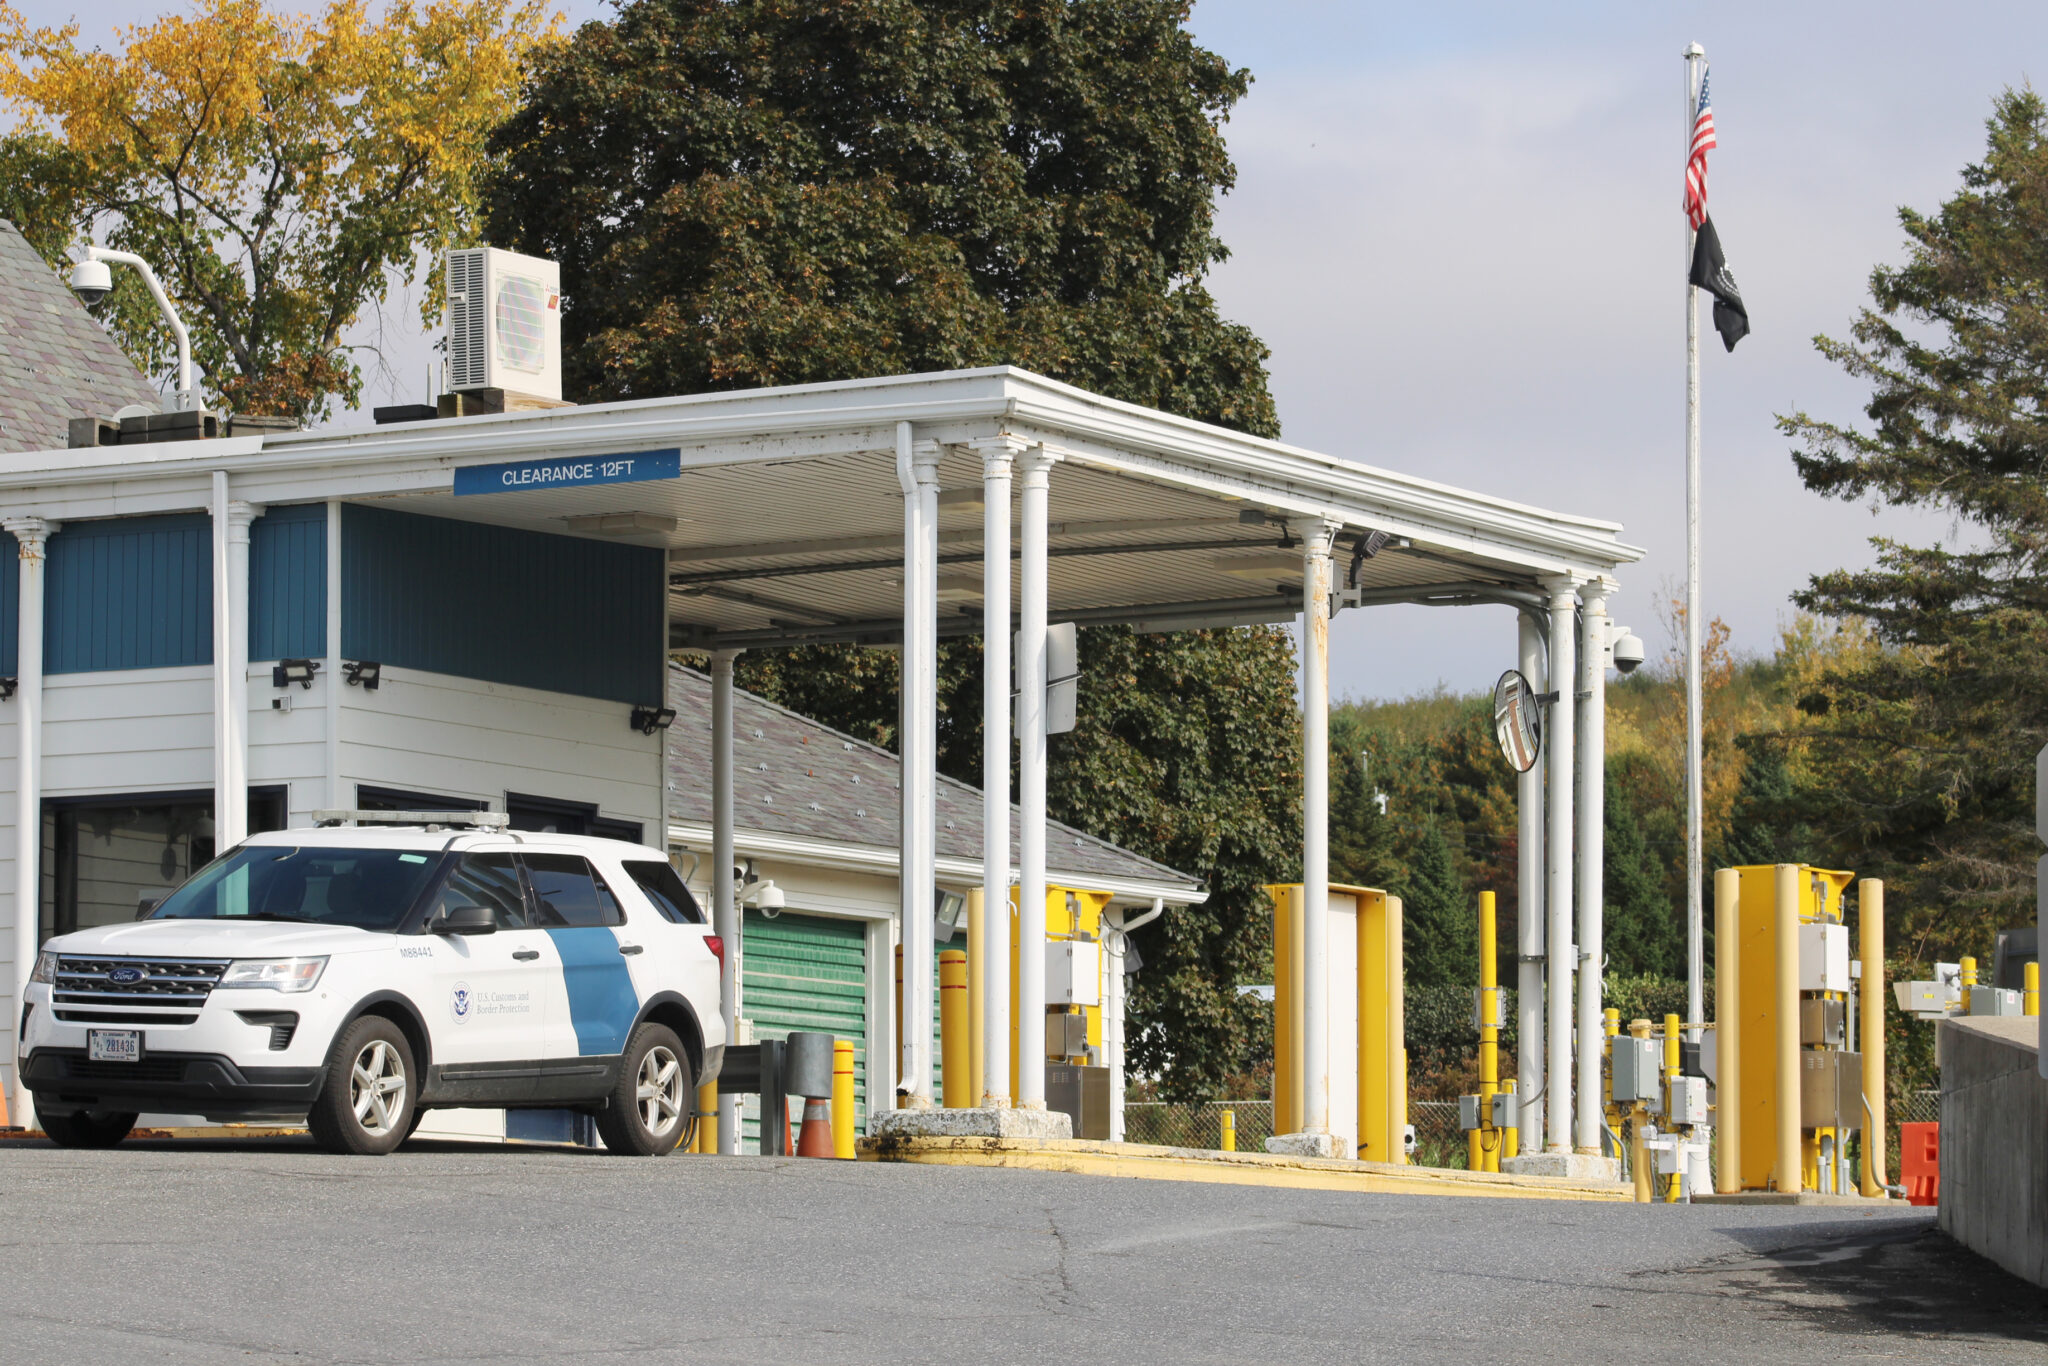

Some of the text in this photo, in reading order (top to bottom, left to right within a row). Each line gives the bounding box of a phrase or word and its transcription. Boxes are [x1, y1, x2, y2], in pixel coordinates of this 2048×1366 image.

[502, 460, 635, 486] CLEARANCE 12FT
[400, 946, 433, 959] M88441
[113, 970, 135, 981] Ford
[477, 990, 529, 1002] U.S. Customs and
[477, 1003, 530, 1015] Border Protection
